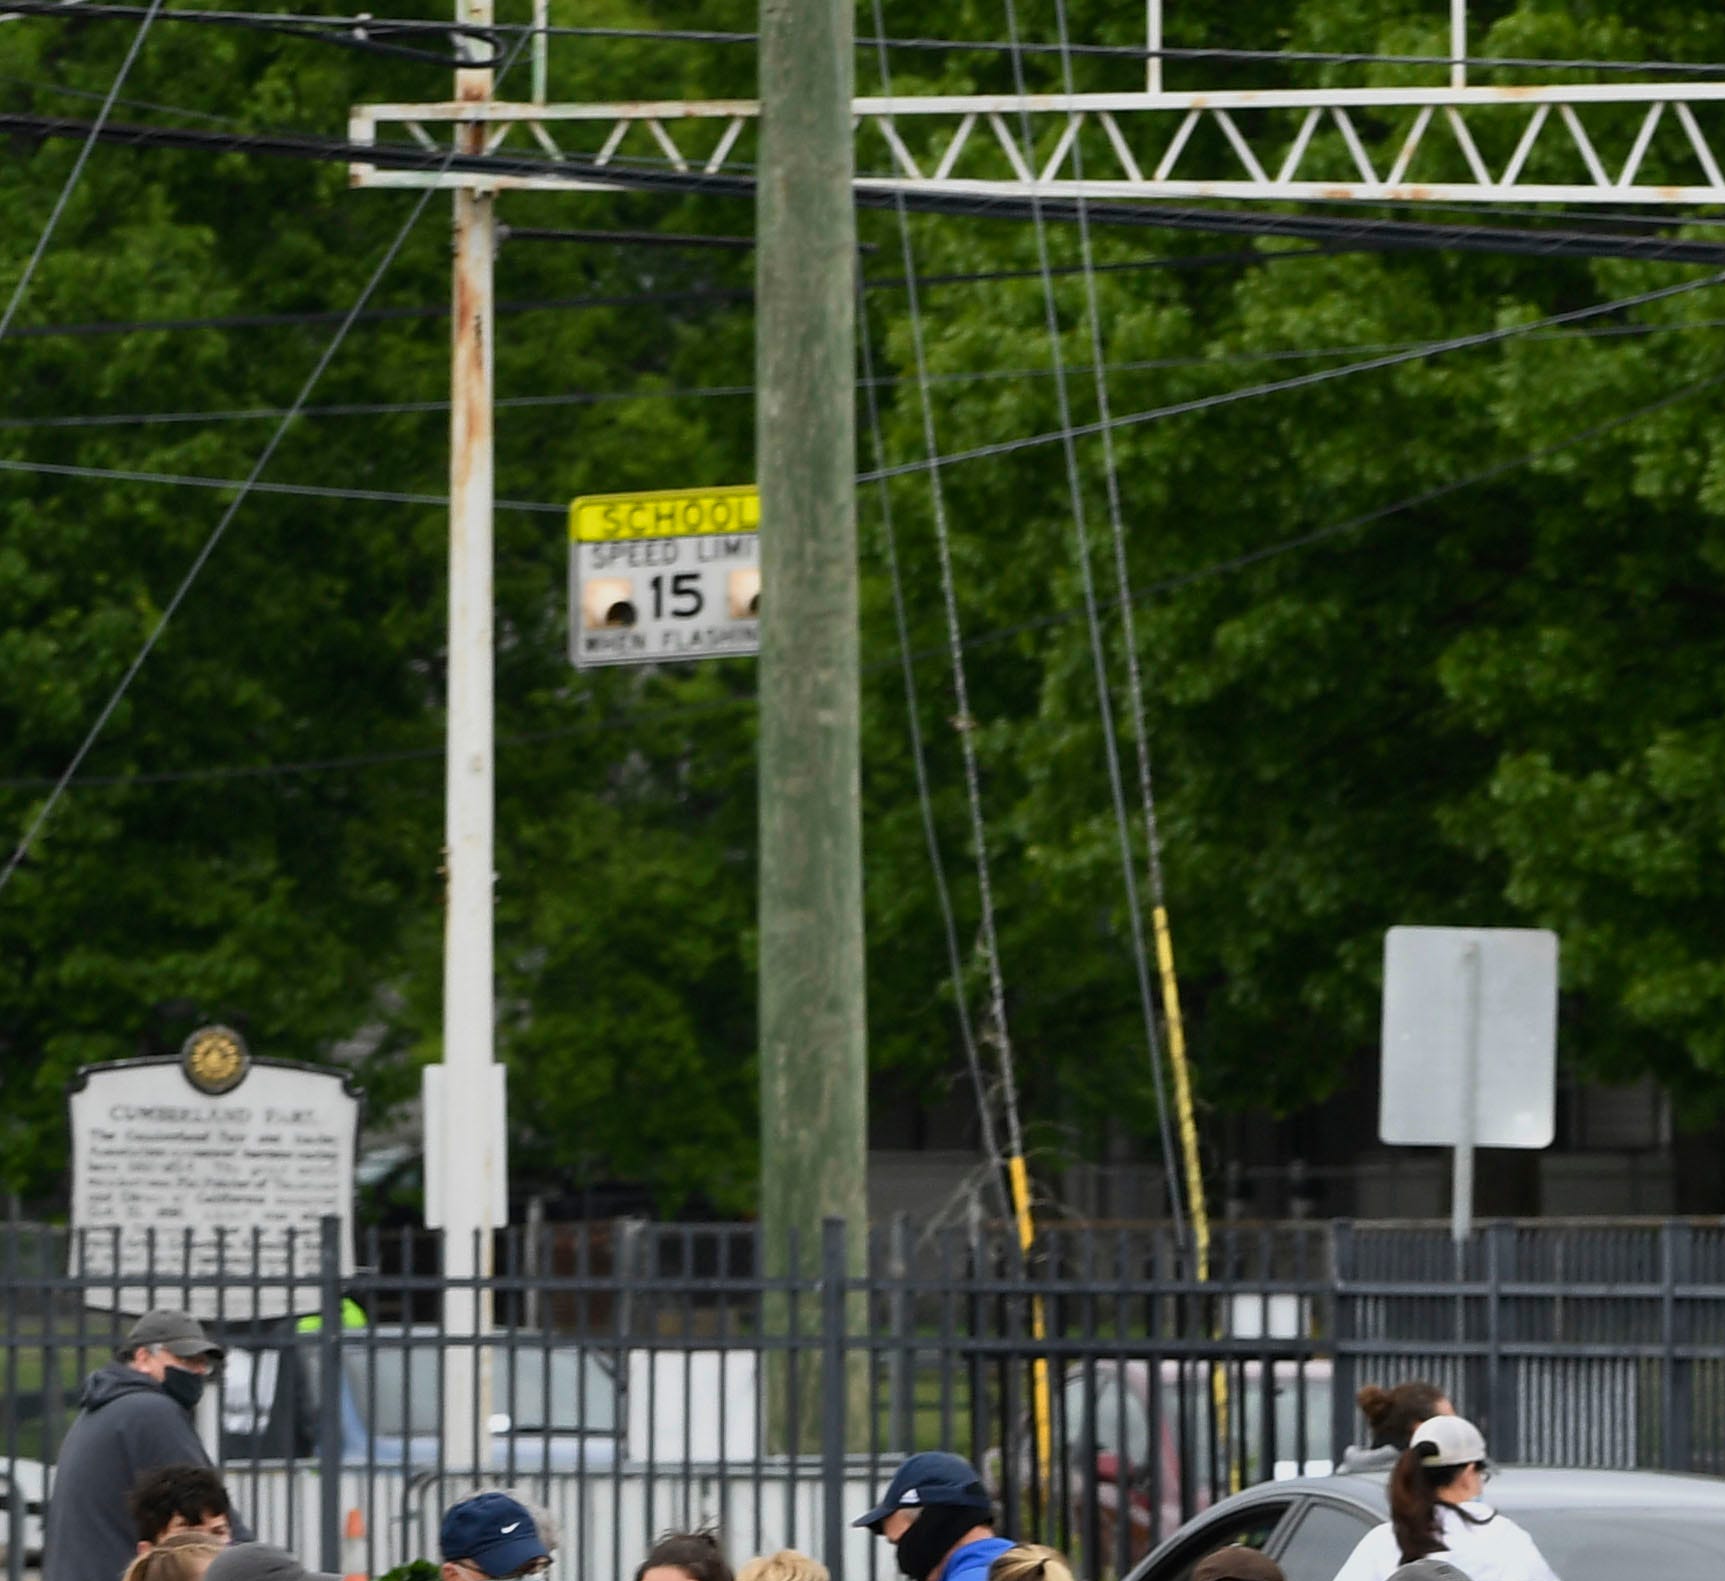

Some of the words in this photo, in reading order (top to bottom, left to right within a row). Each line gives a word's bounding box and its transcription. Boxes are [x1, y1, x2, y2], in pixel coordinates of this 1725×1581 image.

[602, 498, 758, 534] SCHOOL
[592, 540, 678, 570] SPEED
[650, 573, 704, 619] 15
